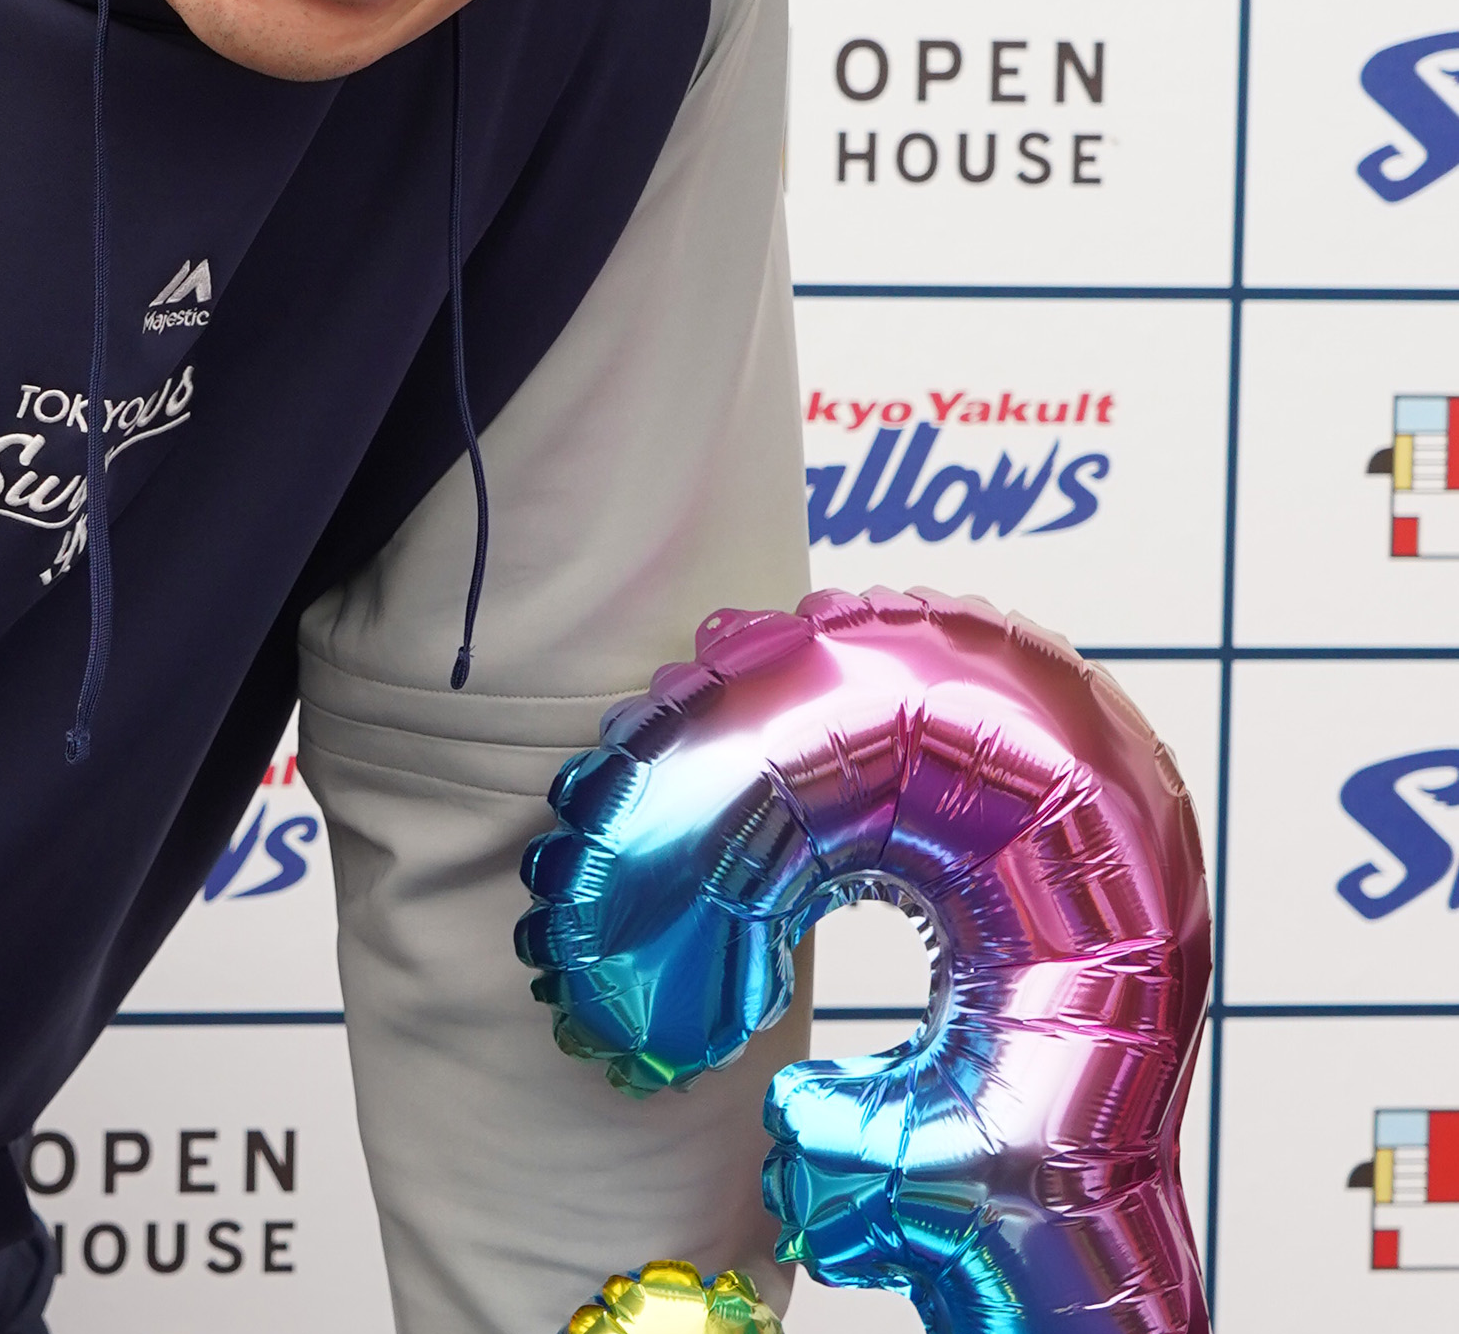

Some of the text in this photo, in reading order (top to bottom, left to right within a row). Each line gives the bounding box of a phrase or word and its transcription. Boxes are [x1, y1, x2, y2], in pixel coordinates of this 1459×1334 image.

[835, 38, 1106, 104] OPEN
[837, 131, 1104, 185] HOUSE
[143, 308, 210, 335] Majestic
[928, 391, 1116, 425] Yakult
[23, 1130, 297, 1195] OPEN
